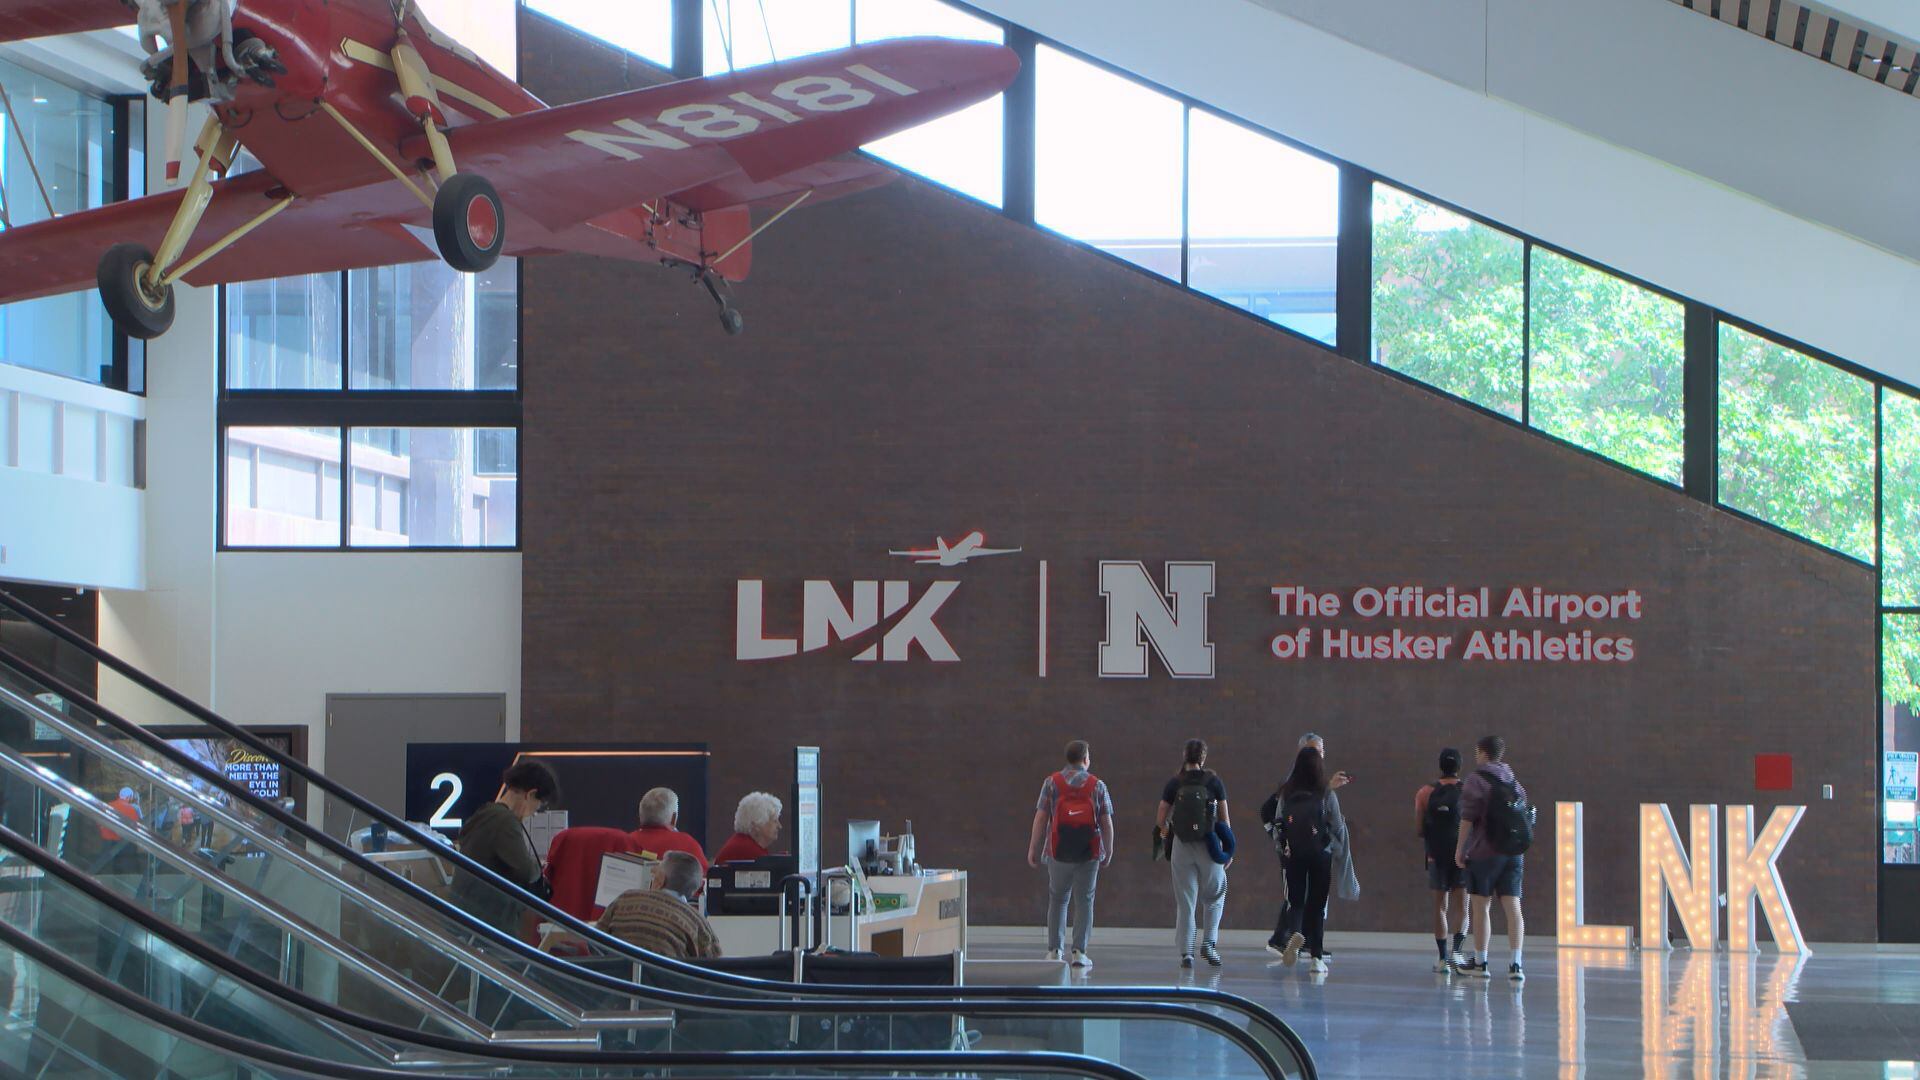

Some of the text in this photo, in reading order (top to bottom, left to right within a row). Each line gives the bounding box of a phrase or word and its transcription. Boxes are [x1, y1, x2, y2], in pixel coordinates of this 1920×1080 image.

[564, 64, 919, 161] N8181
[736, 580, 962, 661] LNK
[1098, 560, 1216, 679] N
[1271, 586, 1642, 624] The Official Airport
[1271, 628, 1635, 662] of Husker Athletics
[225, 763, 279, 772] MORE THAN
[226, 749, 269, 764] Discov
[229, 772, 279, 780] MEETS THE
[429, 772, 463, 828] 2
[1555, 801, 1813, 954] LNK
